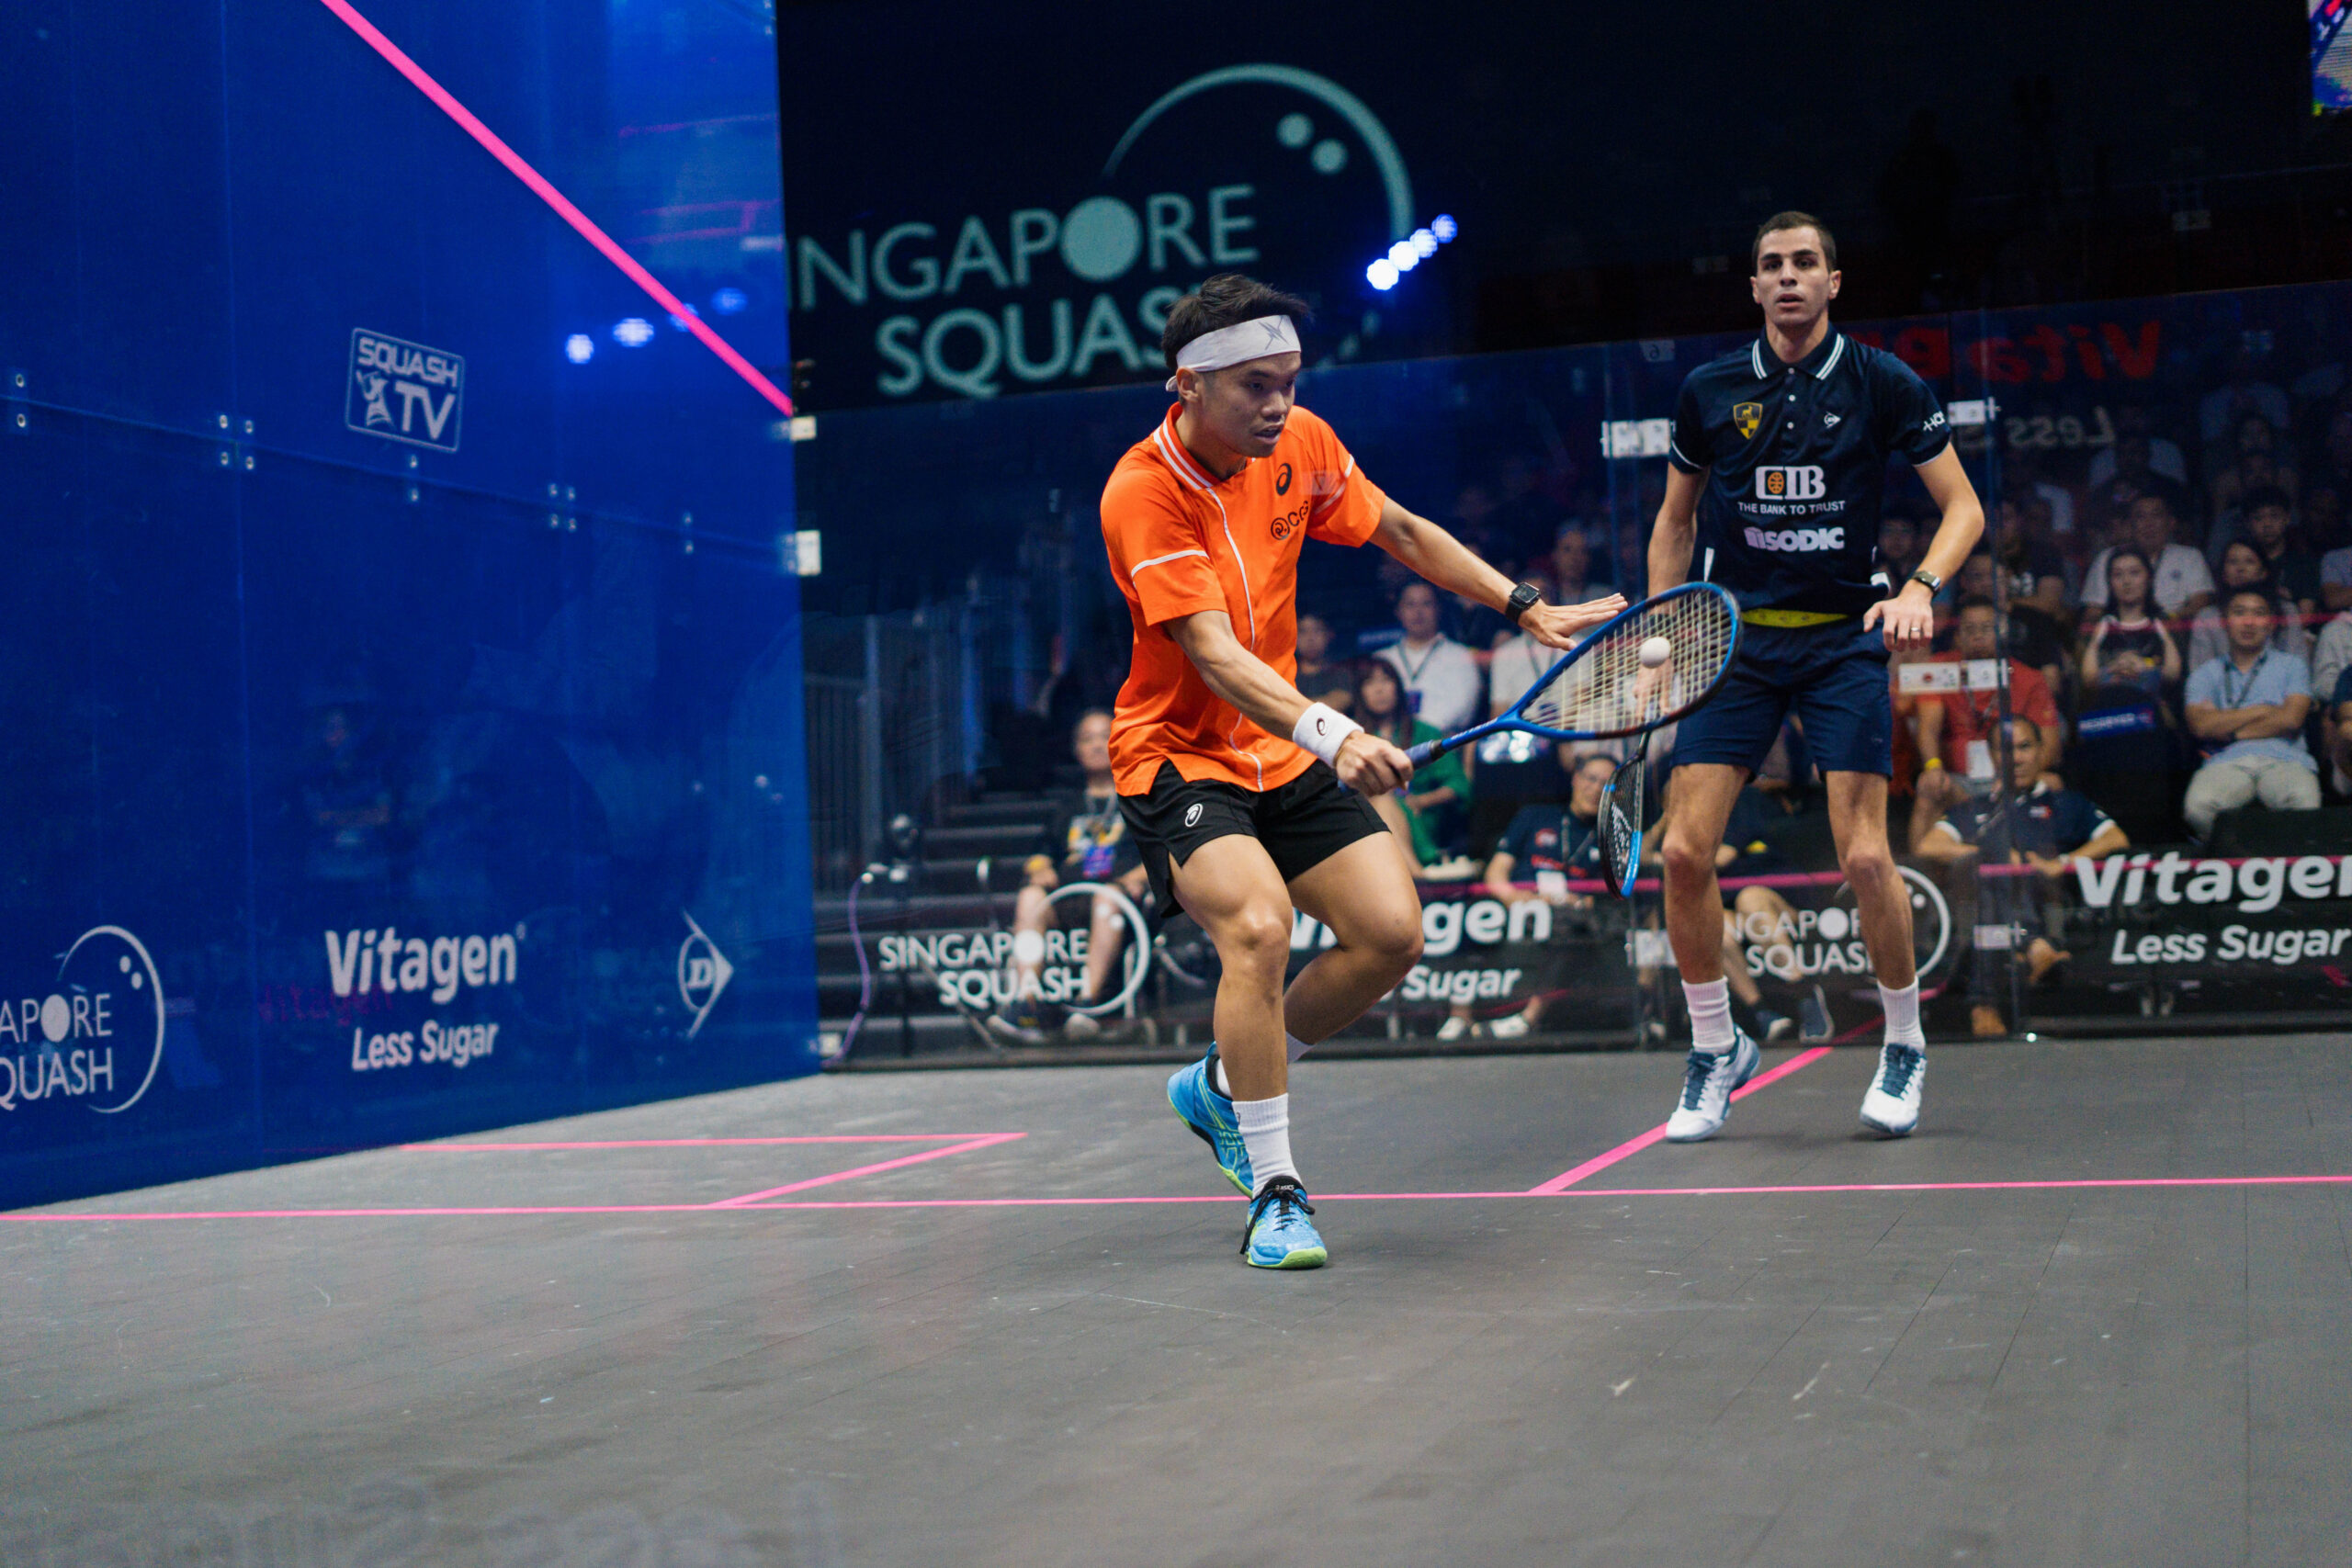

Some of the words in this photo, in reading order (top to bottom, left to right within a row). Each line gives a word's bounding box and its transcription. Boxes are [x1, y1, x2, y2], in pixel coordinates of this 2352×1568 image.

[788, 185, 1259, 310] NGAPORE
[358, 336, 458, 388] SQUASH
[876, 286, 1196, 398] SQUAS
[395, 380, 456, 439] TV
[1756, 466, 1826, 500] CIB
[1738, 502, 1758, 513] THE
[1760, 504, 1787, 514] BANK
[1790, 504, 1806, 514] TO
[1809, 501, 1846, 513] TRUST
[324, 927, 517, 1004] Vitagen
[878, 928, 1090, 971] SINGAPORE
[1746, 942, 1874, 982] SQUAS
[2110, 929, 2207, 964] Less
[2217, 924, 2352, 964] Sugar
[939, 964, 1091, 1010] SQUASH
[1401, 965, 1522, 1005] Sugar
[352, 1026, 413, 1071] Less
[420, 1020, 499, 1068] Sugar
